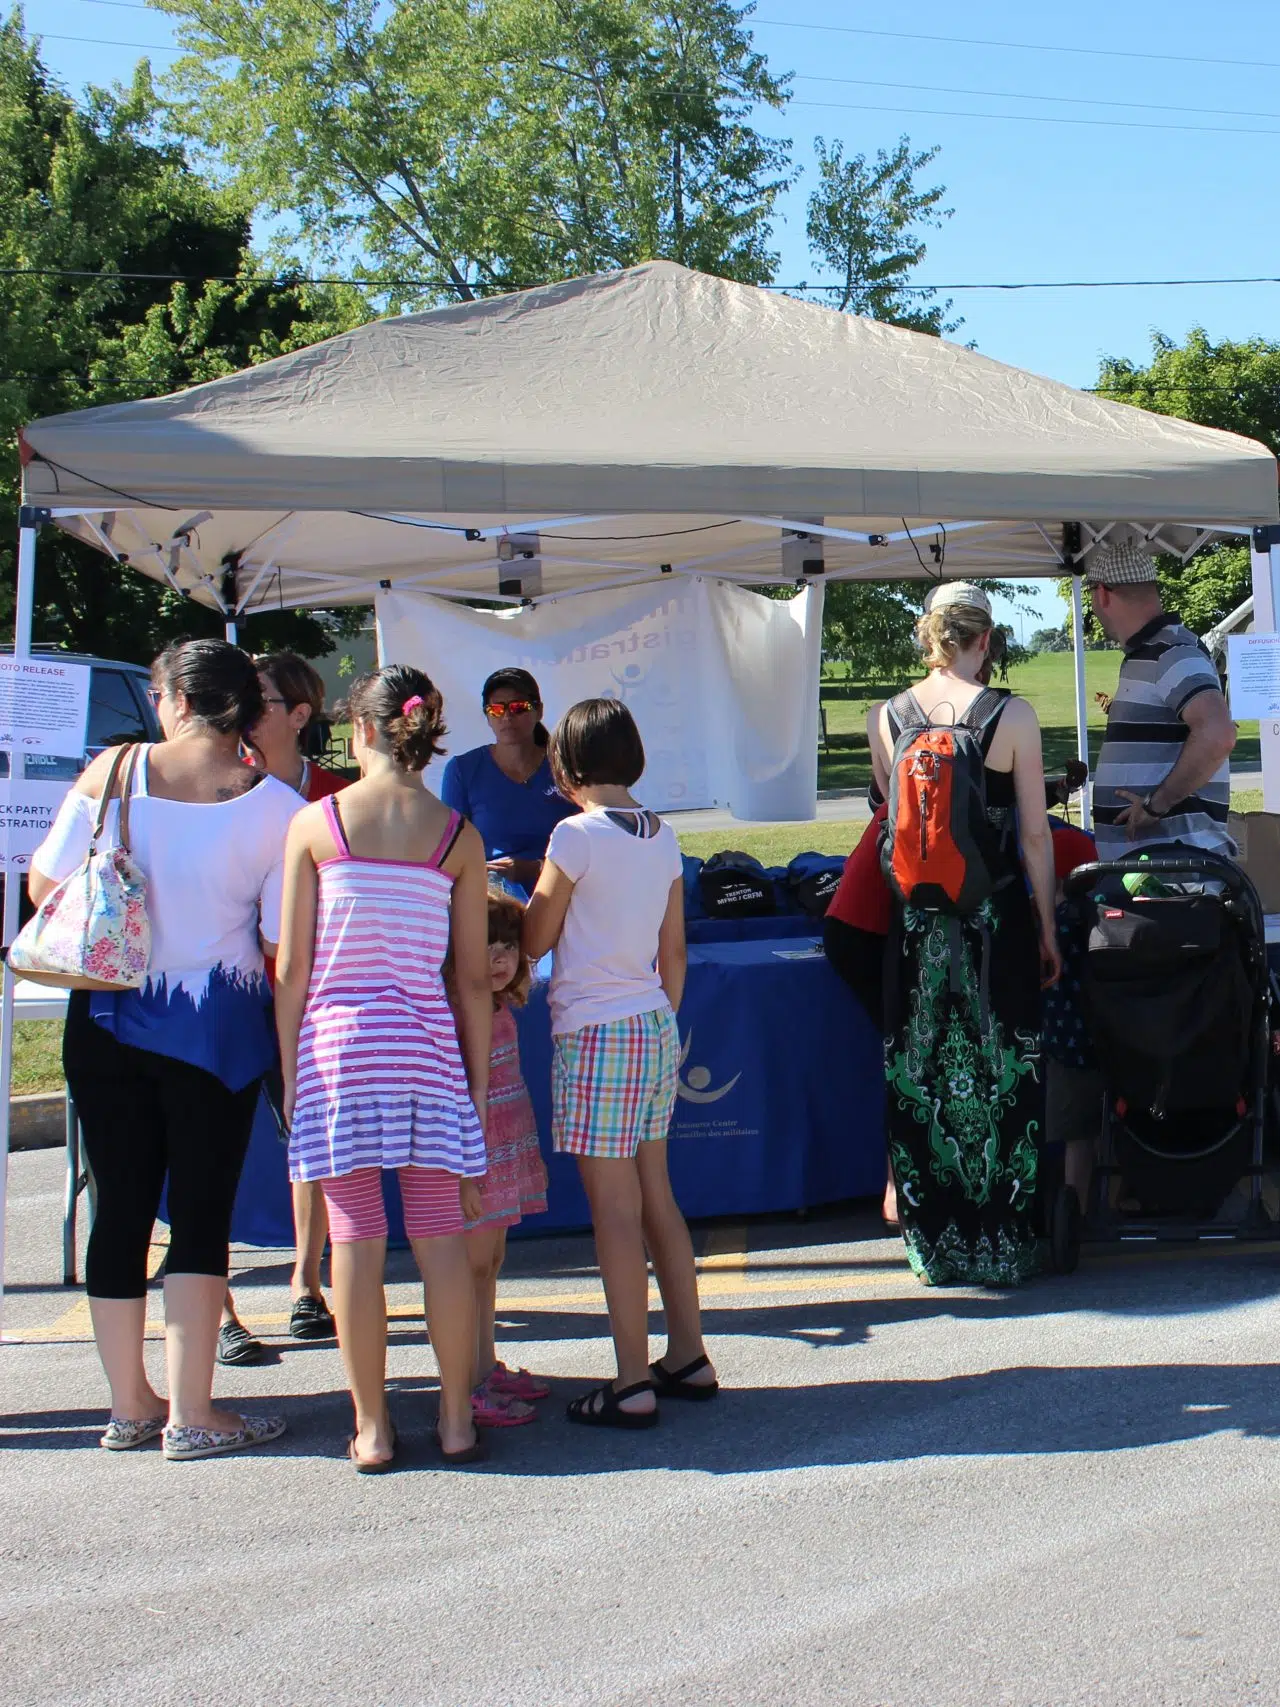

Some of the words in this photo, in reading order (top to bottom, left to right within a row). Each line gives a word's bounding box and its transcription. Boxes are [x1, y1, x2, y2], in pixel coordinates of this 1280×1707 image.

[0, 663, 20, 672] OTO
[22, 665, 65, 676] RELEASE
[16, 806, 53, 815] PARTY
[725, 888, 752, 898] TRENTON
[742, 891, 763, 901] CRFM
